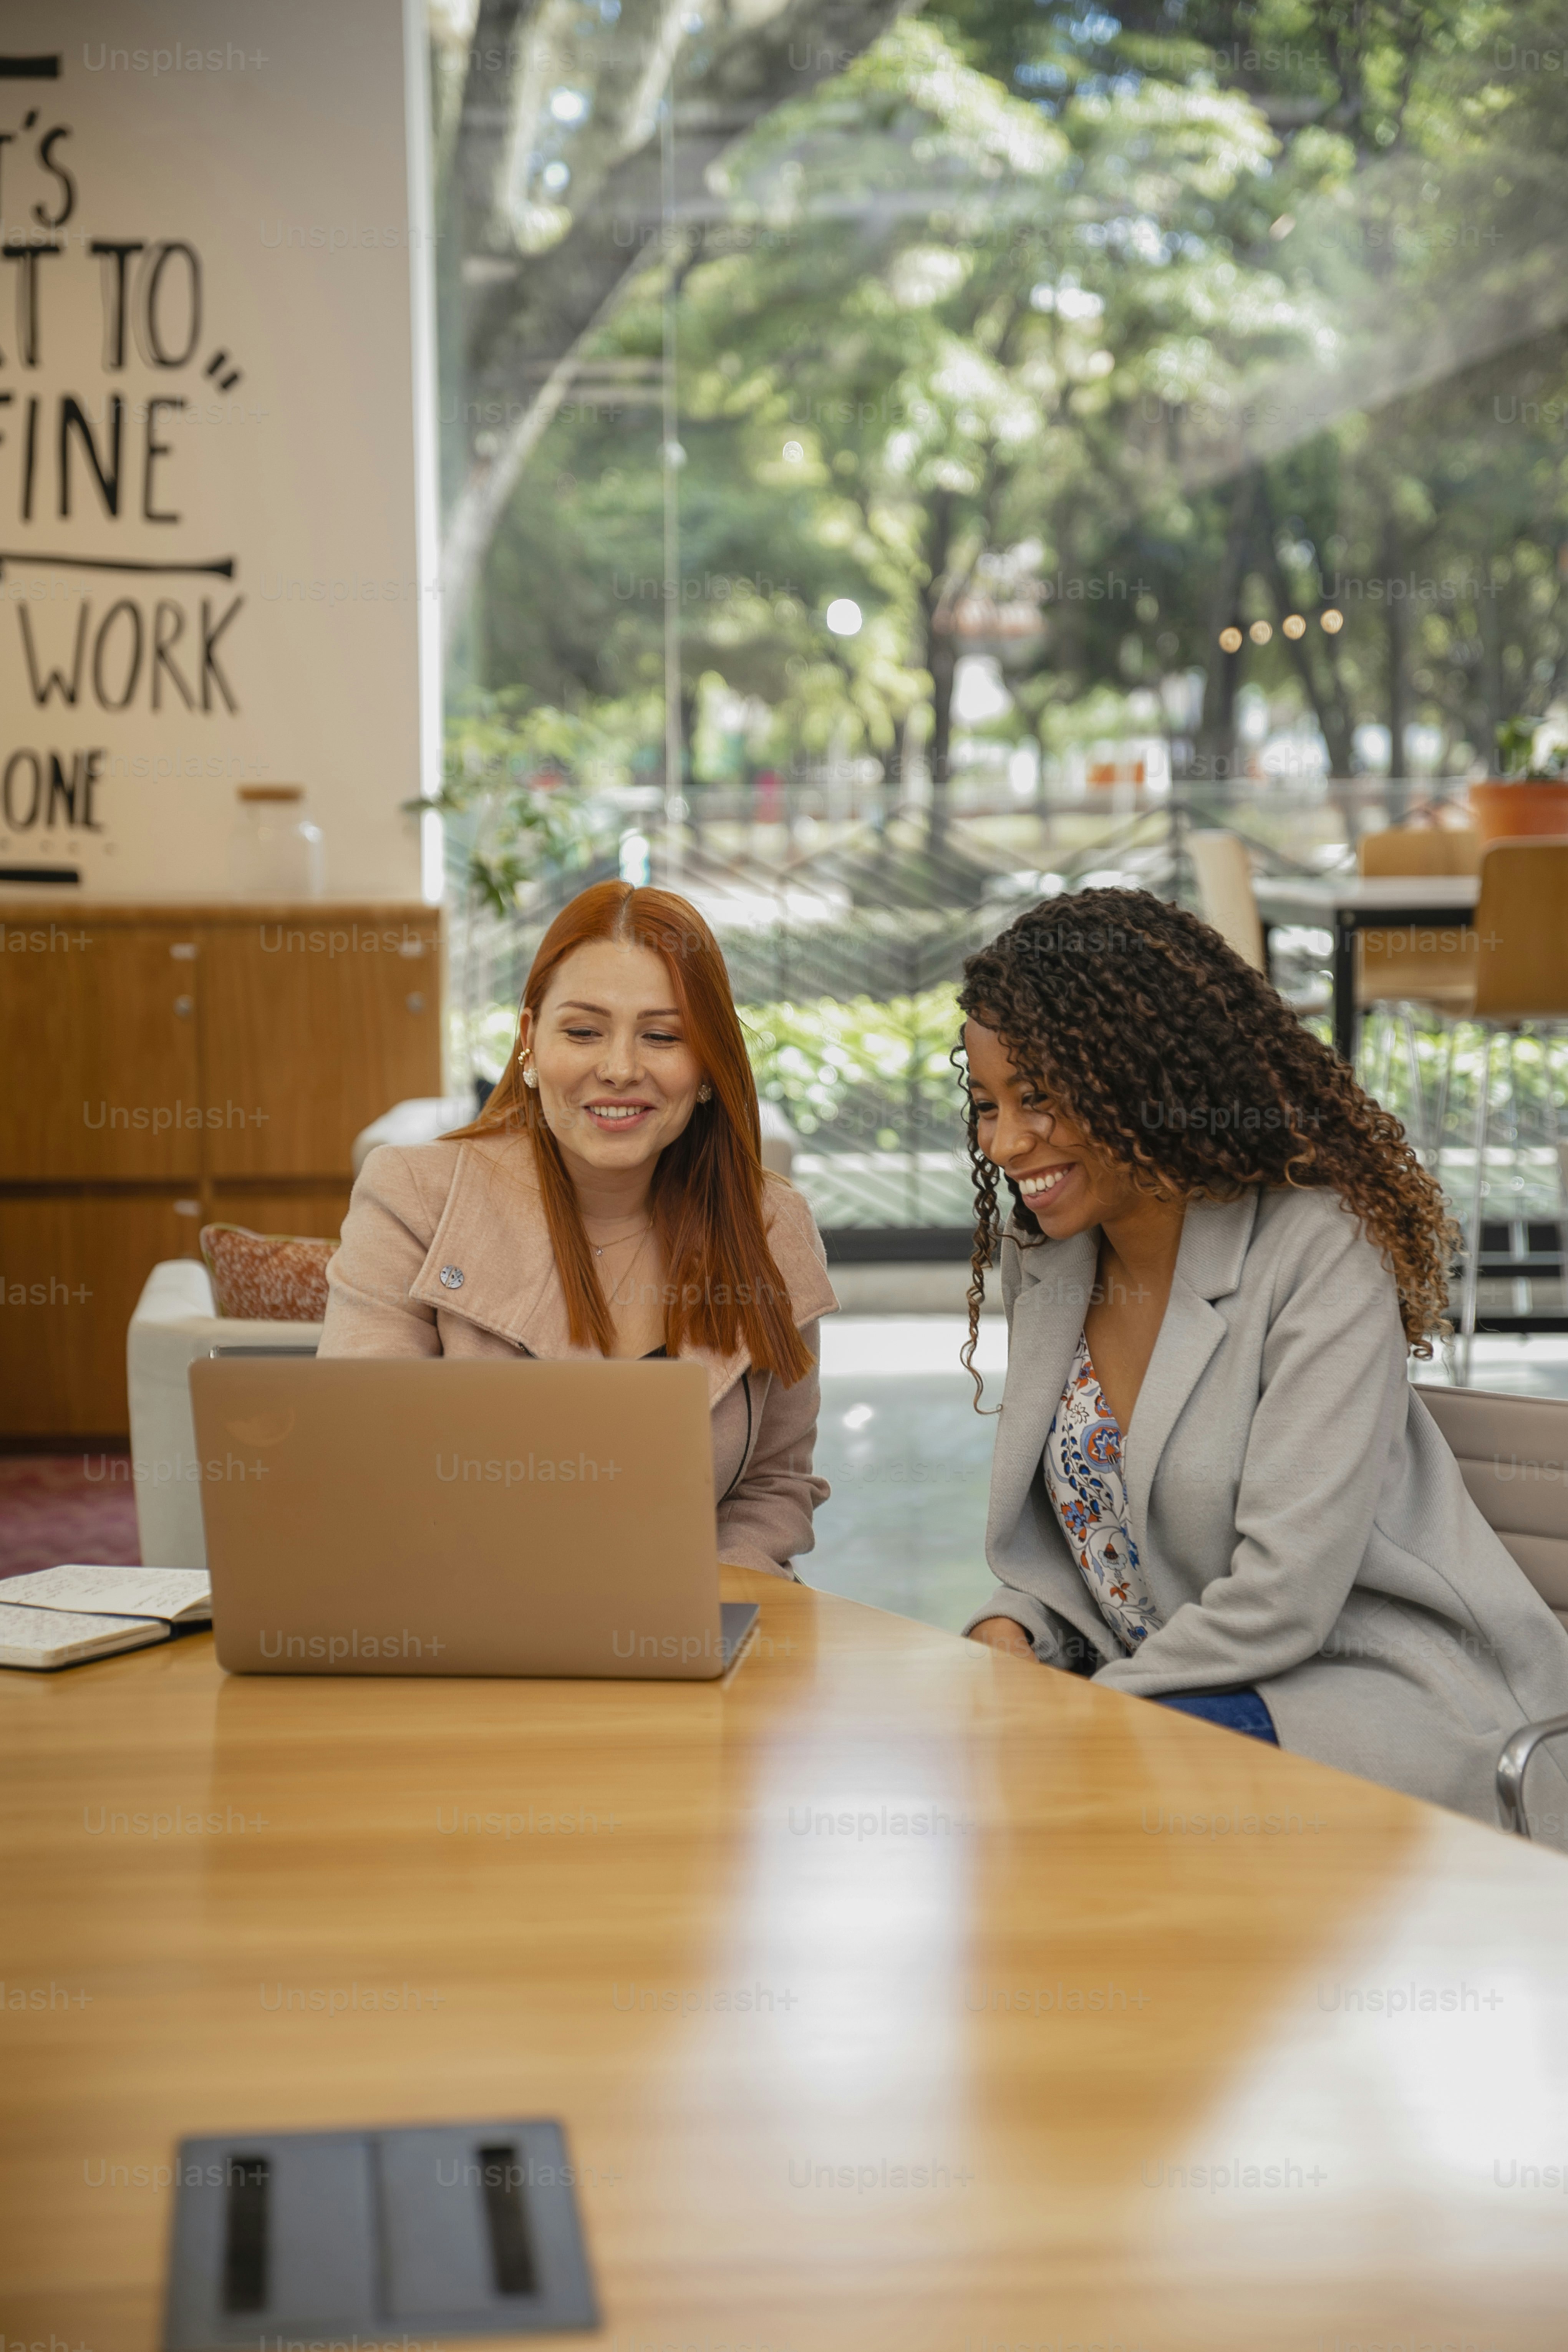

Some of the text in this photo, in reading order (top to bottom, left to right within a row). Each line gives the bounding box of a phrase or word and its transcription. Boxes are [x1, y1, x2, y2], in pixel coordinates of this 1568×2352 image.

[0, 241, 203, 372] T TO
[0, 392, 185, 523] INE
[17, 595, 245, 715] WORK
